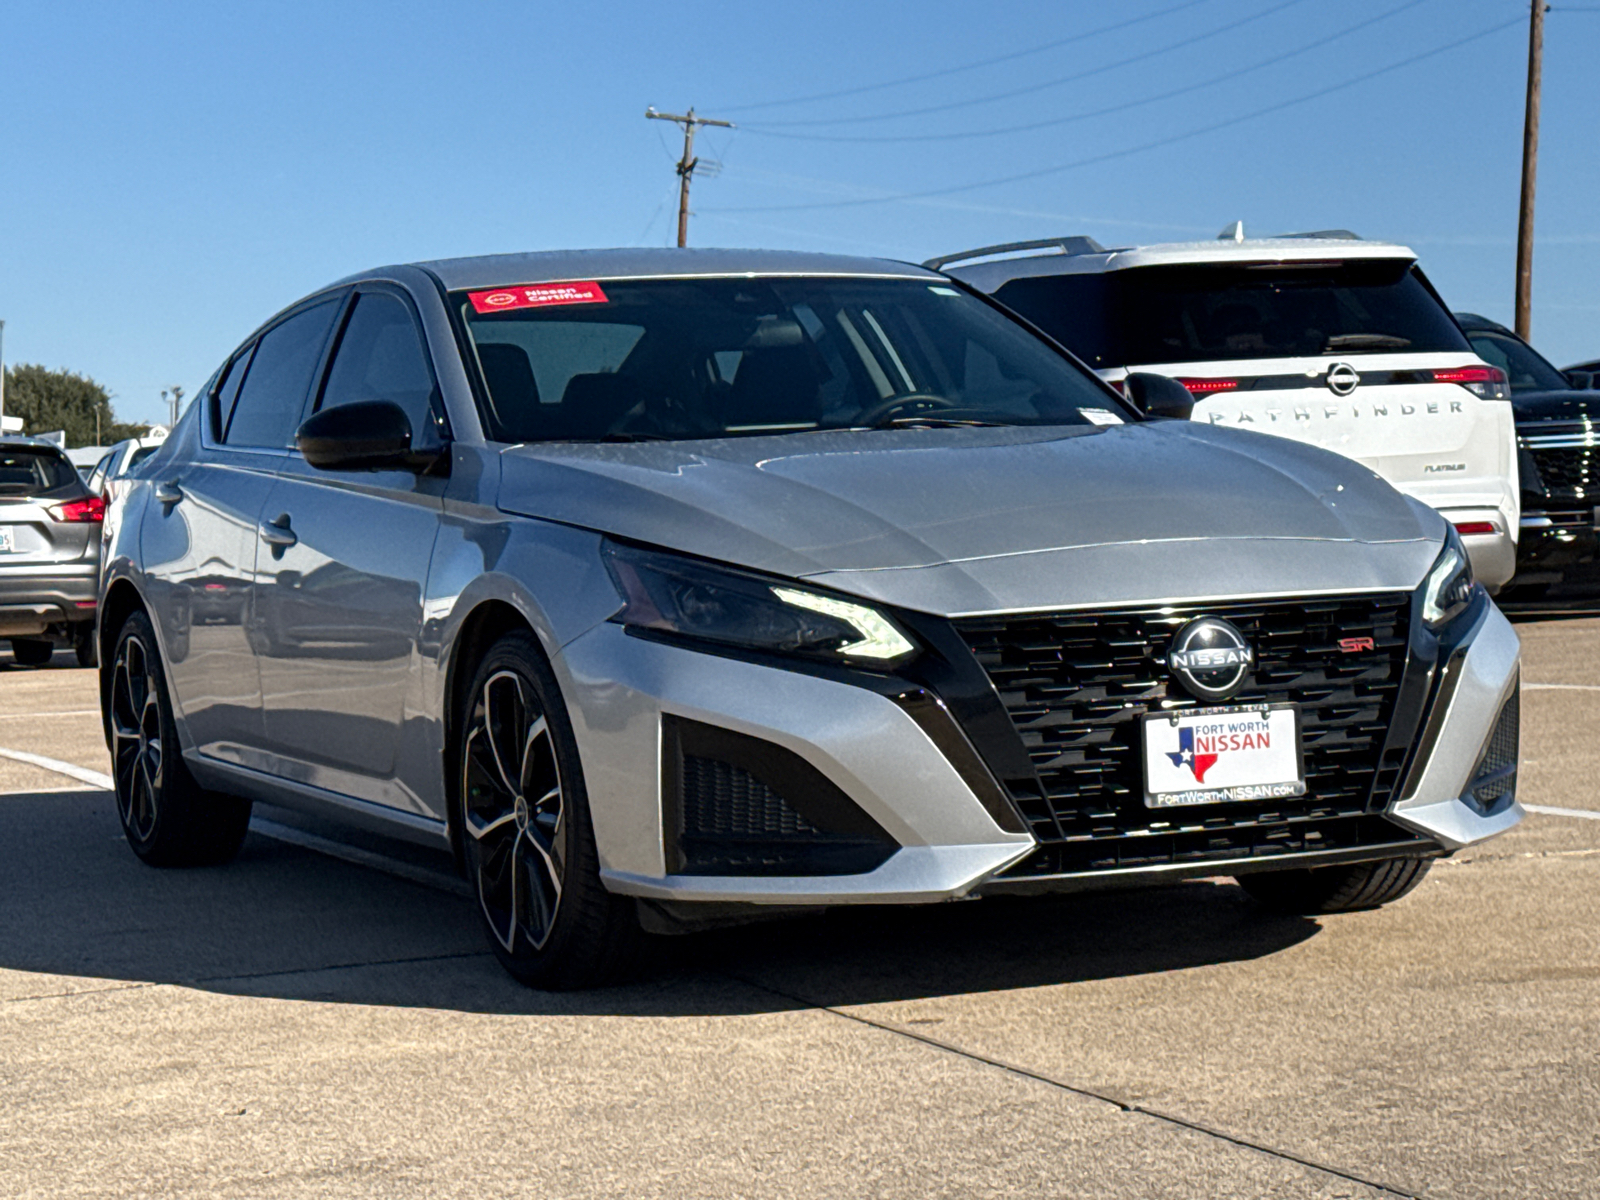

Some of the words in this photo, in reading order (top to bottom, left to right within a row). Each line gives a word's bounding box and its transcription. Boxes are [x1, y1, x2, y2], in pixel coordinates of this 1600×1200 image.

[525, 287, 577, 297] Nissan
[528, 292, 593, 301] Certified
[1208, 401, 1464, 425] PATHFINDER
[1337, 636, 1374, 653] SR
[1172, 649, 1253, 668] NISSAN
[1195, 723, 1225, 735] FORT
[1228, 721, 1270, 733] WORTH
[1196, 731, 1271, 753] NISSAN
